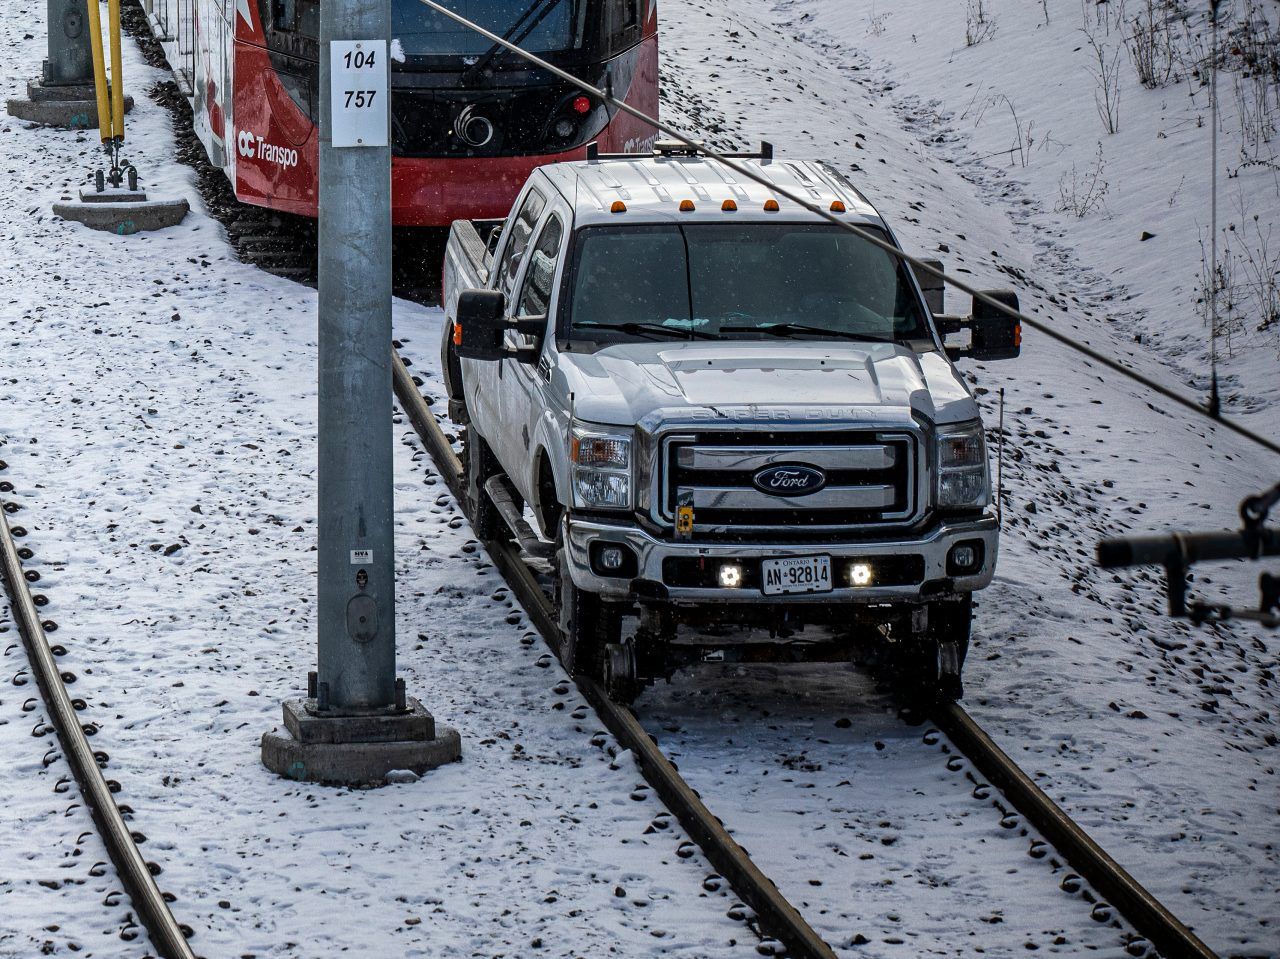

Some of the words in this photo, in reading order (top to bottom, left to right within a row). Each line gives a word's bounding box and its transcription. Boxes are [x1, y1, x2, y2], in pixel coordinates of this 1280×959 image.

[344, 50, 375, 68] 104
[344, 90, 376, 108] 757
[238, 130, 255, 158] OC
[256, 136, 298, 170] Transpo
[692, 409, 790, 420] SUPER
[771, 470, 809, 487] Ford
